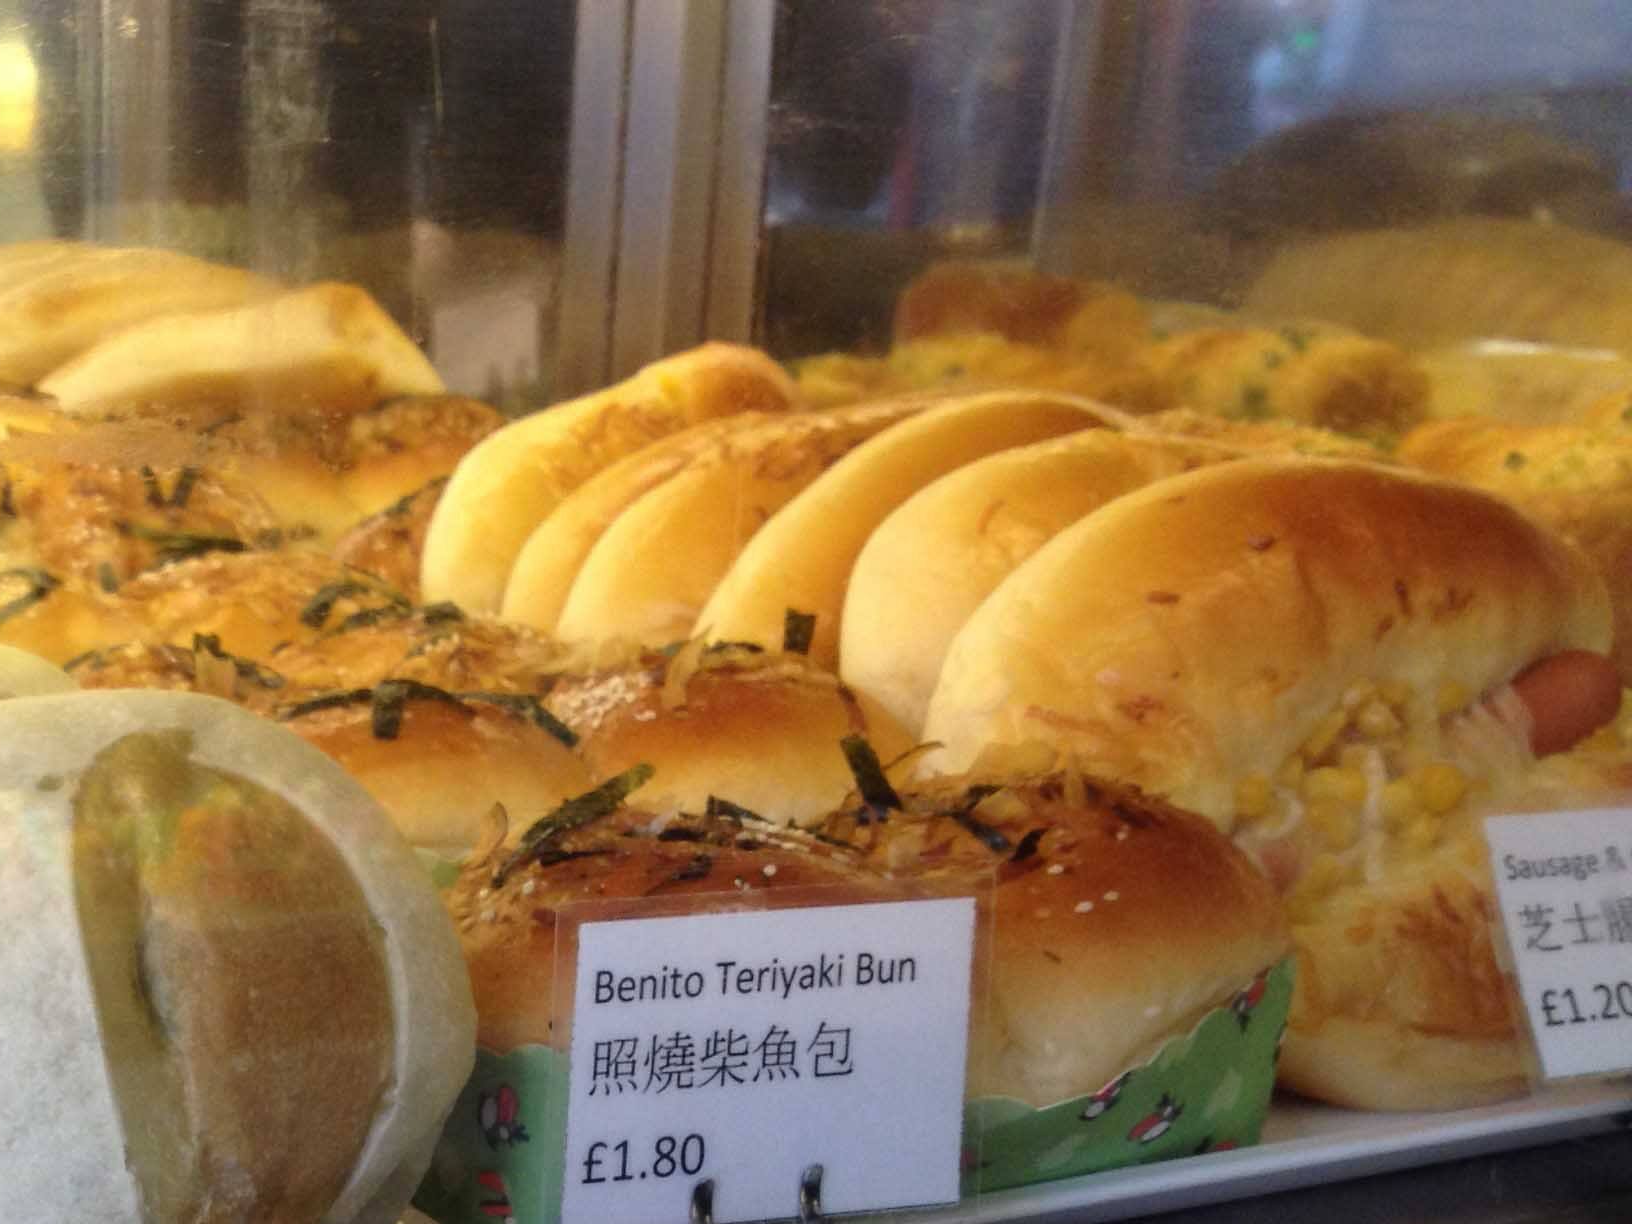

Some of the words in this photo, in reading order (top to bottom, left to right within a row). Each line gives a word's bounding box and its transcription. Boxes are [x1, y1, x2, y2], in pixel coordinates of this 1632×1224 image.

[1504, 853, 1599, 881] Sausage
[1605, 846, 1628, 872] &
[594, 966, 704, 1004] Benito
[715, 953, 845, 999] Teriyaki
[855, 952, 916, 986] Bun
[1541, 981, 1632, 1026] £1.20
[588, 1021, 854, 1096] 照燒柴魚包
[581, 1133, 705, 1184] £1.80
